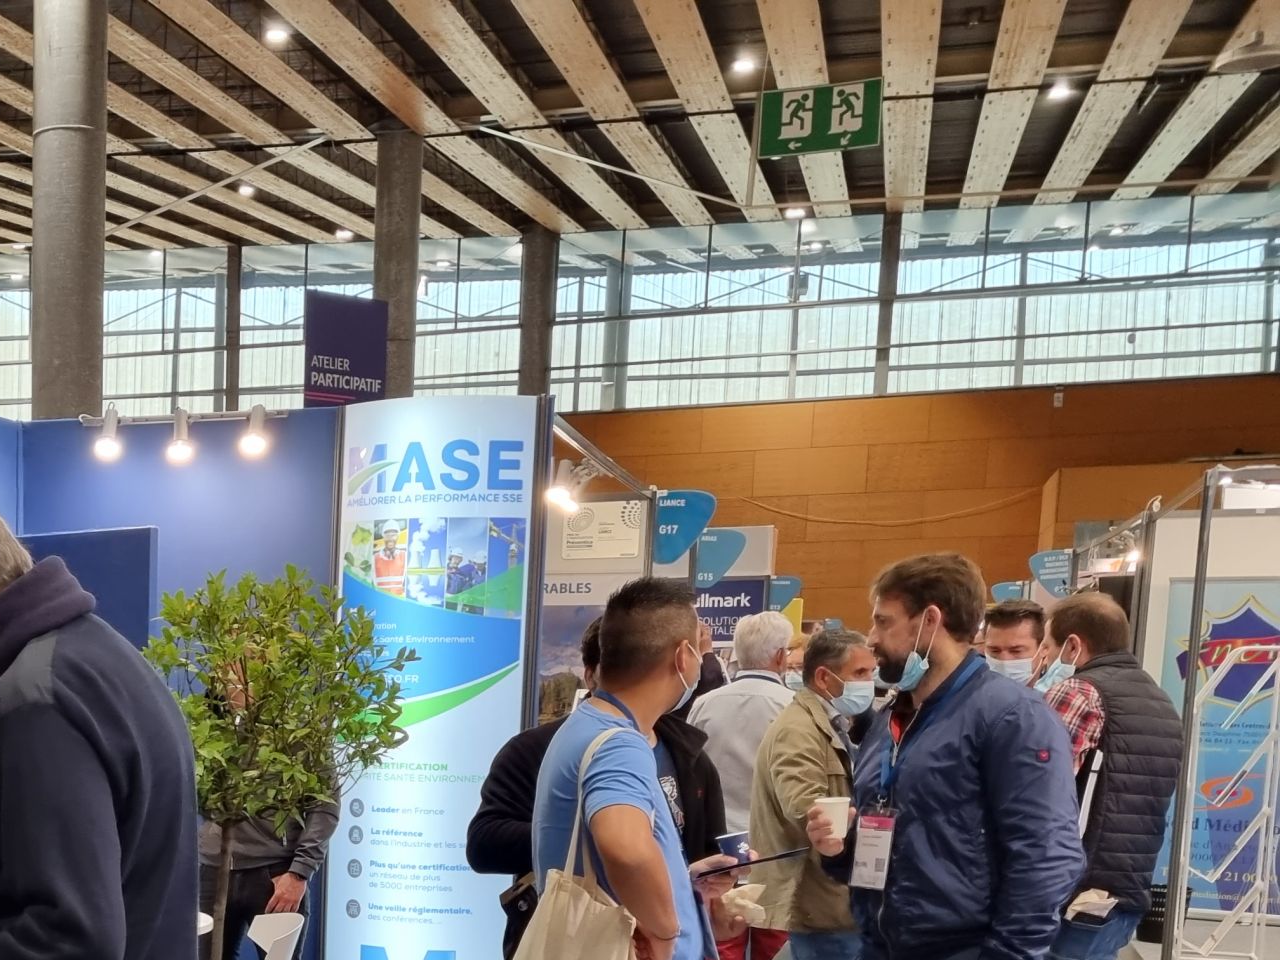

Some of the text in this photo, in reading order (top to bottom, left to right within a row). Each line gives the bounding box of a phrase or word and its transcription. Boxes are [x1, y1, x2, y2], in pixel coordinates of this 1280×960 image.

[311, 354, 350, 371] ATELIER
[310, 371, 382, 393] PARTICIPATIF
[347, 438, 524, 496] MASE
[346, 492, 523, 508] AMÉLIORER LA PERFORMANCE SSE
[659, 524, 679, 534] G17
[697, 572, 714, 581] G15
[379, 635, 404, 643] Santé
[405, 634, 475, 643] Environnement
[371, 805, 401, 813] Leader
[414, 807, 445, 815] France
[370, 827, 423, 837] La référence
[370, 838, 389, 846] dans
[444, 840, 457, 849] les
[369, 860, 386, 868] Plus
[387, 862, 416, 871] qu'une
[380, 871, 408, 880] réseau
[410, 873, 421, 881] de
[422, 874, 441, 883] plus
[404, 883, 453, 893] entreprises
[368, 902, 384, 910] Une
[384, 903, 407, 912] veille
[367, 913, 381, 921] des
